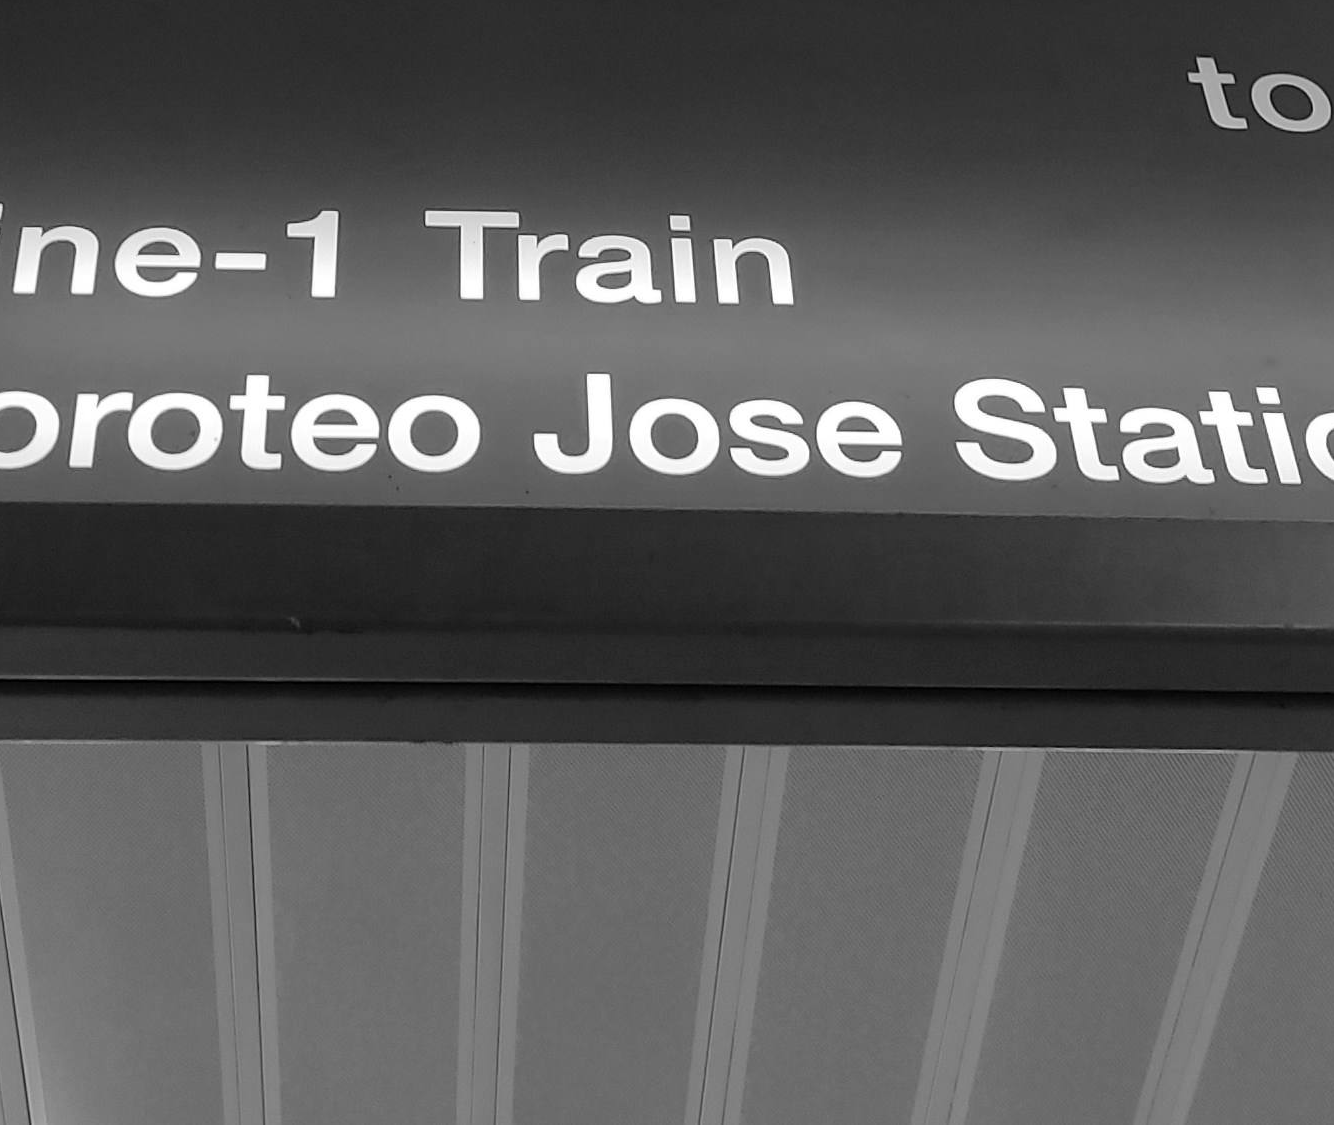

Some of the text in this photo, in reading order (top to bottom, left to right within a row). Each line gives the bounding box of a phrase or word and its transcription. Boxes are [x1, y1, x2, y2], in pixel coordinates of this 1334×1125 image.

[1186, 56, 1333, 133] to
[423, 209, 795, 305] Train
[532, 372, 903, 477] Jose
